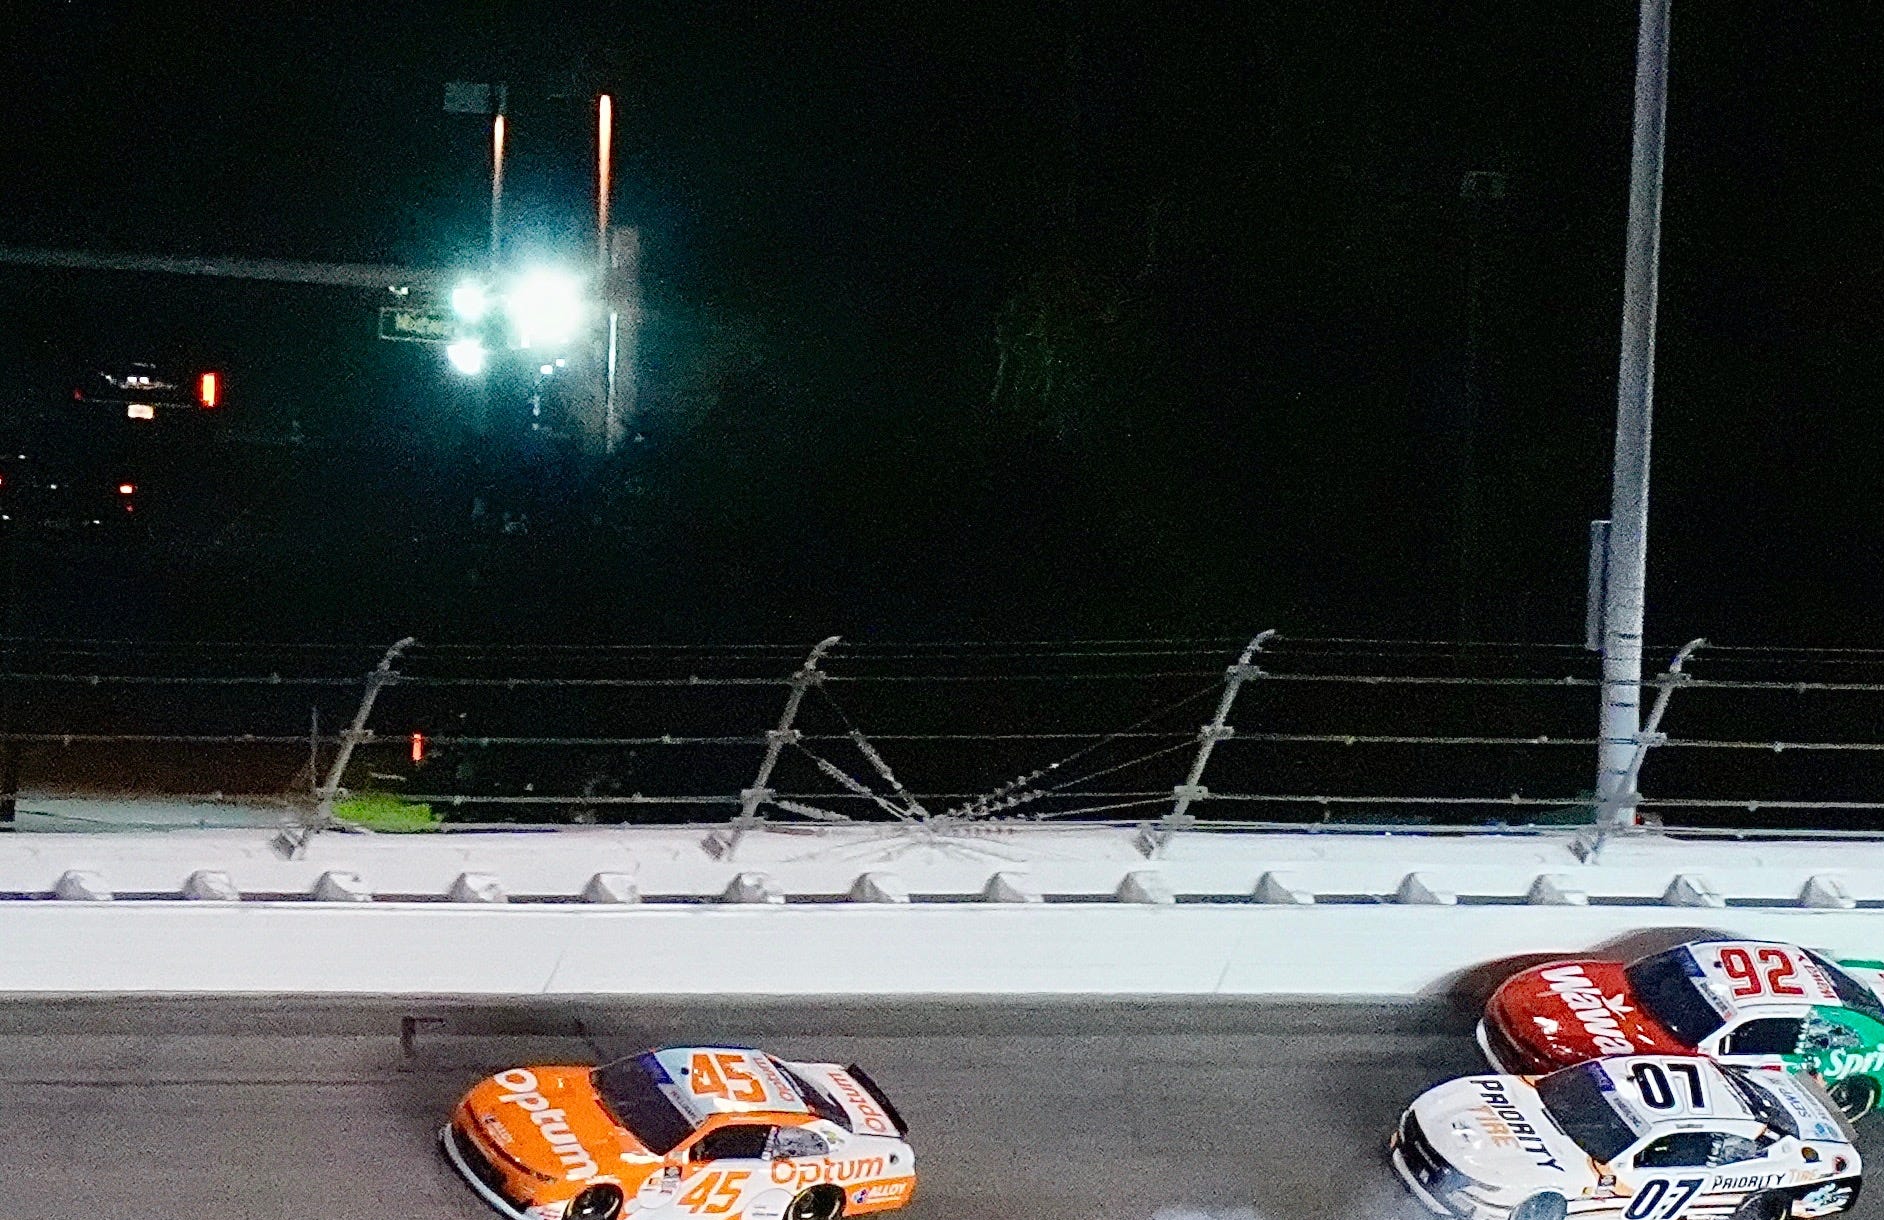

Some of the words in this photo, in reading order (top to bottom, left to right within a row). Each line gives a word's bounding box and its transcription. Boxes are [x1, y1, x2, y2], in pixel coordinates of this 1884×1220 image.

[1720, 948, 1804, 997] 92
[1541, 965, 1635, 1055] Wawa
[691, 1054, 767, 1102] 45
[1631, 1062, 1705, 1109] 07
[494, 1068, 599, 1182] Optum
[827, 1072, 888, 1132] Optum
[1470, 1080, 1565, 1172] PRIORITY
[677, 1171, 752, 1214] 45
[770, 1157, 884, 1190] Optum
[869, 1182, 907, 1196] ALLOY
[1712, 1173, 1786, 1190] PRIORITY
[1624, 1178, 1705, 1220] 07
